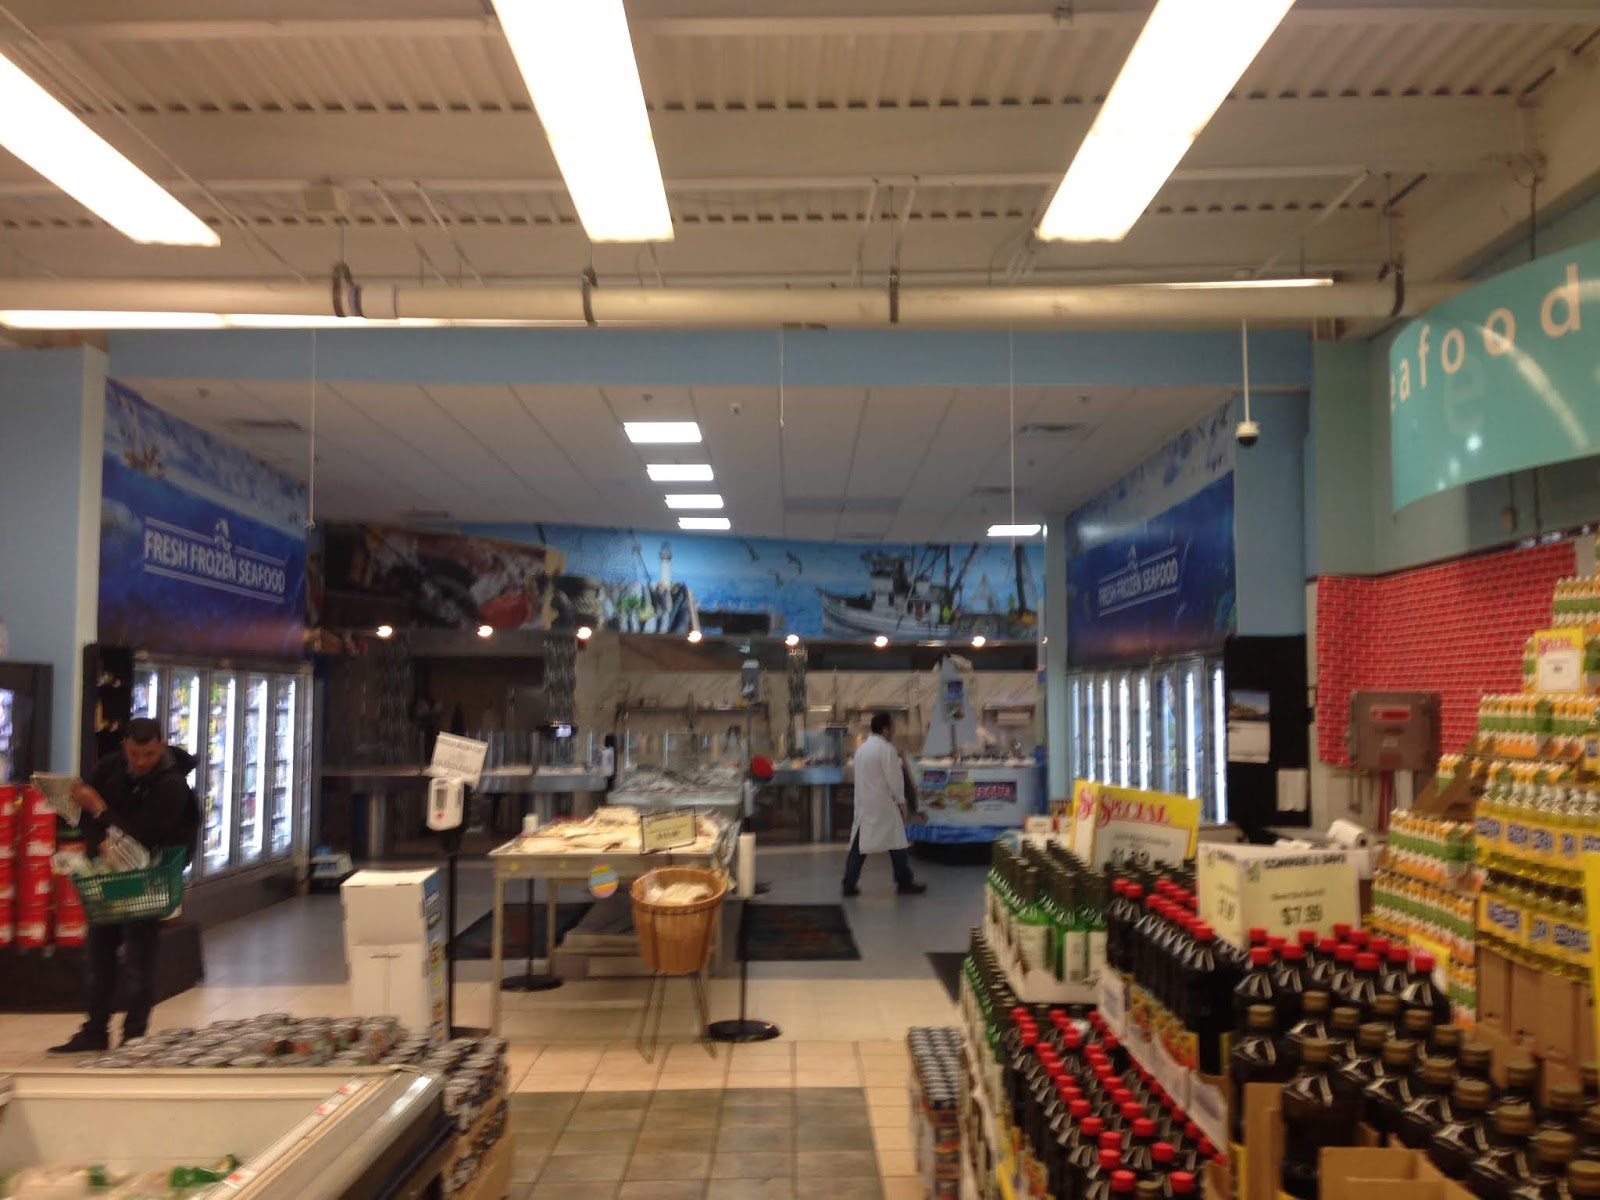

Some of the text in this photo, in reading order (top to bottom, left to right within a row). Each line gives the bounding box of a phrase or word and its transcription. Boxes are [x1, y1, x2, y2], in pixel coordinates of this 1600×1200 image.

[144, 529, 286, 594] FRESH FROZEN SEAFOOD
[1143, 558, 1178, 592] SEAFOOD
